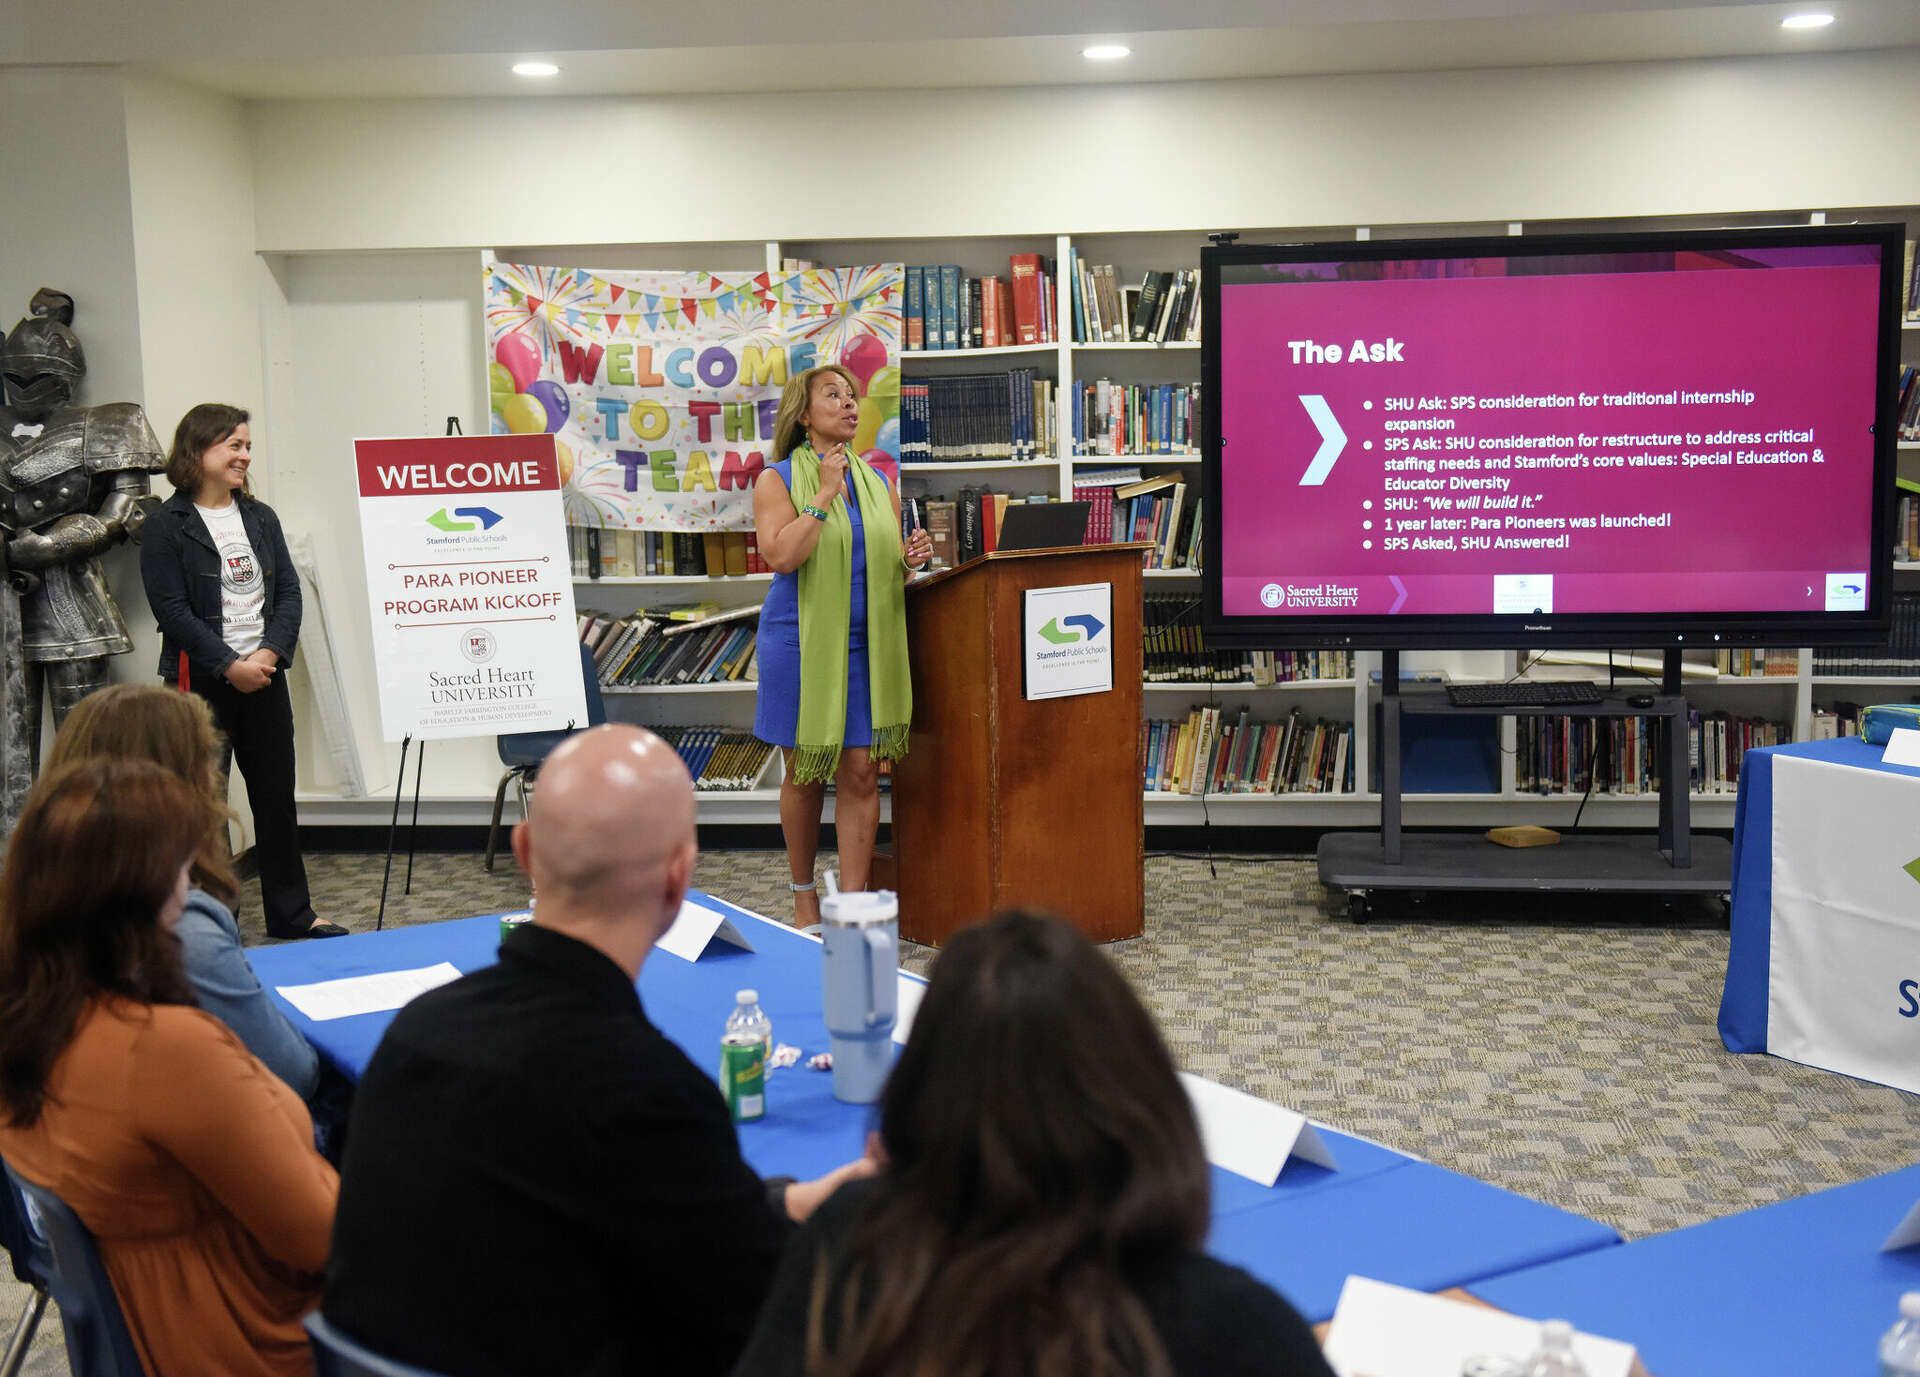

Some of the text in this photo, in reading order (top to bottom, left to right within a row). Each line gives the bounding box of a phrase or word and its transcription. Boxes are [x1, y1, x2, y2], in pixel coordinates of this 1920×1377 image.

[1287, 337, 1405, 364] The Ask
[557, 341, 817, 388] WELCOME
[1384, 389, 1755, 411] SHU Ask: SPS consideration for traditional internship
[596, 398, 779, 443] TO THE
[1384, 416, 1455, 433] expansion
[1384, 428, 1814, 451] SPS Ask: SHU consideration for restructure to address critical
[615, 450, 765, 492] TEAM
[1384, 448, 1824, 473] staffing needs and Stamford’s core values: Special Education &
[376, 460, 541, 489] WELCOME
[1384, 475, 1510, 492] Educator Diversity
[1384, 494, 1544, 511] SHU: “We will build it.”
[1384, 513, 1671, 533] 1 year later: Para Pioneers was launched!
[426, 534, 508, 545] Stamford Public Schools
[1384, 534, 1570, 551] SPS Asked, SHU Answered!
[403, 568, 538, 589] PARA PIONEER
[1286, 584, 1359, 597] Sacred Heart
[384, 592, 562, 616] PROGRAM KICKOFF
[1286, 596, 1359, 608] UNIVERSITY
[1036, 645, 1107, 660] Stamford Public Schools
[429, 667, 535, 687] Sacred Heart
[431, 683, 536, 704] UNIVERSITY
